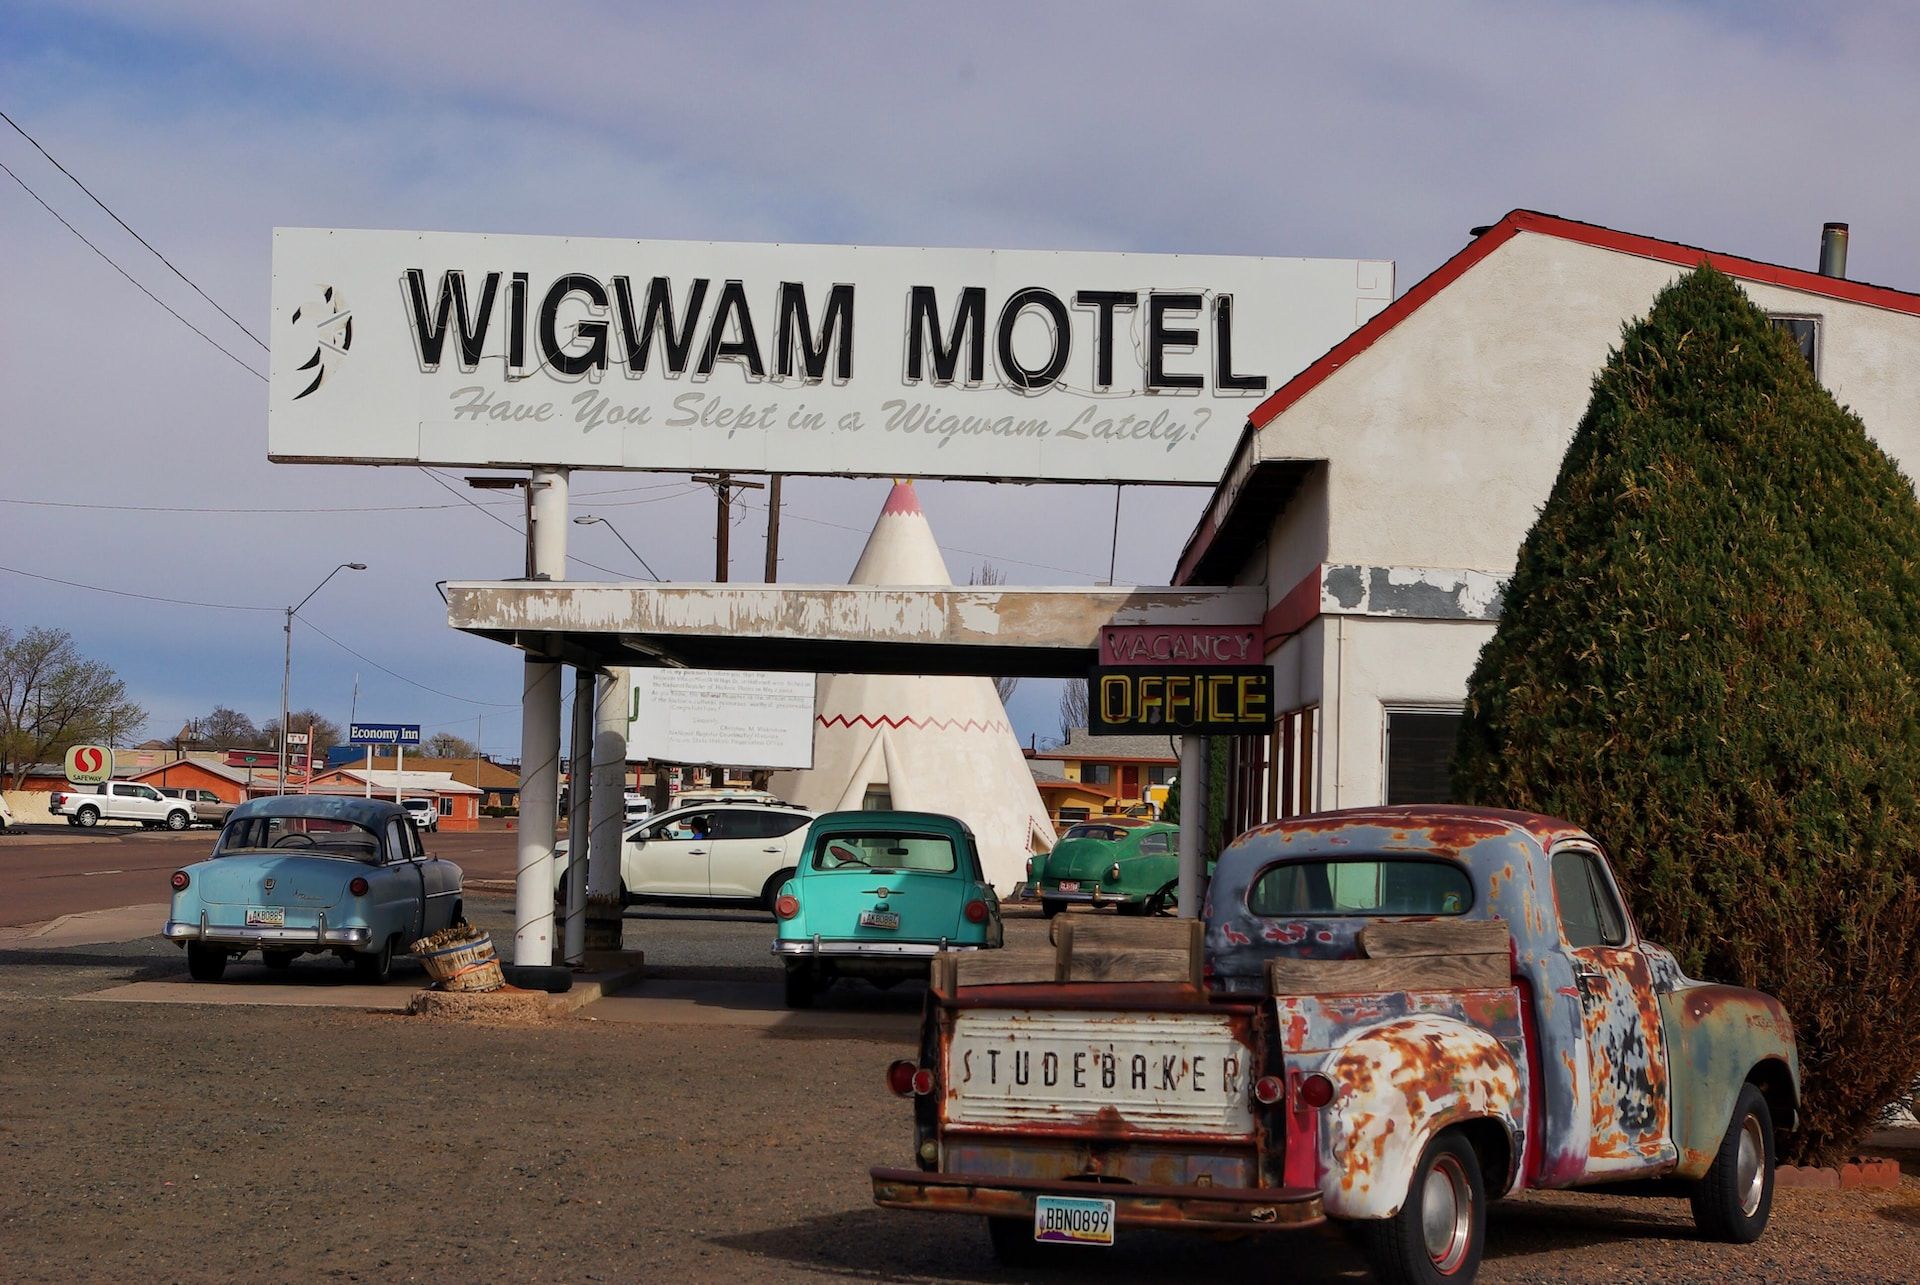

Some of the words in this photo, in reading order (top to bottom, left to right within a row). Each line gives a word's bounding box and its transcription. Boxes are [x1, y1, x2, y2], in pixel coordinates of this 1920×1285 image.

[402, 268, 856, 383] WIGWAM
[904, 286, 1268, 391] MOTEL
[450, 386, 554, 422] Have
[571, 389, 652, 434] You
[665, 392, 778, 439] Slept
[788, 404, 825, 431] in
[838, 411, 864, 432] a
[881, 399, 1050, 449] Wigwam
[1056, 404, 1212, 452] Lately?
[1110, 634, 1253, 661] VACANCY
[1101, 675, 1267, 723] OFFICE
[351, 726, 399, 743] Economy
[401, 728, 419, 739] Inn
[963, 1049, 1240, 1093] STUDEBAKER
[1046, 1207, 1109, 1233] BBN0899
